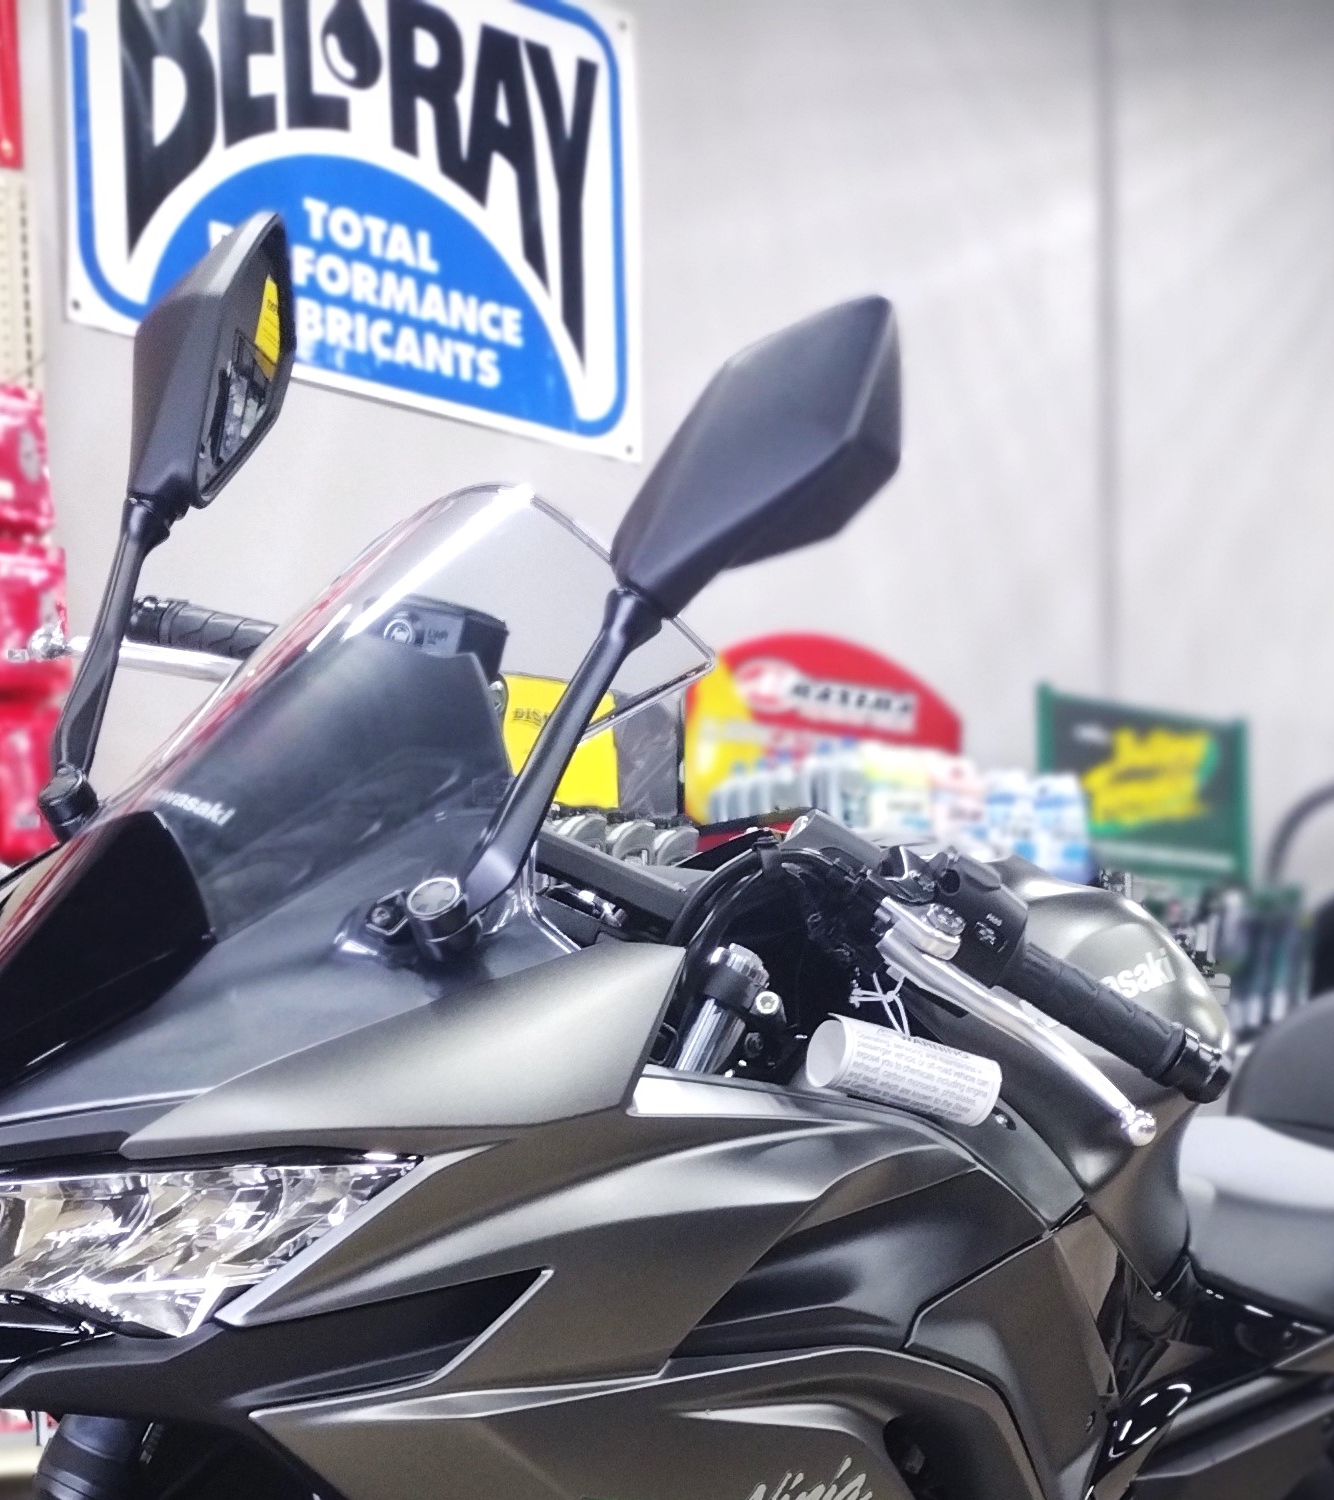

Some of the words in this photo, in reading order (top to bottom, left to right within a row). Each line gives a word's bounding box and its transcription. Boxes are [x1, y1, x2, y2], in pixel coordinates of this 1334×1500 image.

[303, 196, 440, 275] TOTAL
[296, 296, 502, 389] BRICANTS
[1099, 947, 1176, 999] asaki
